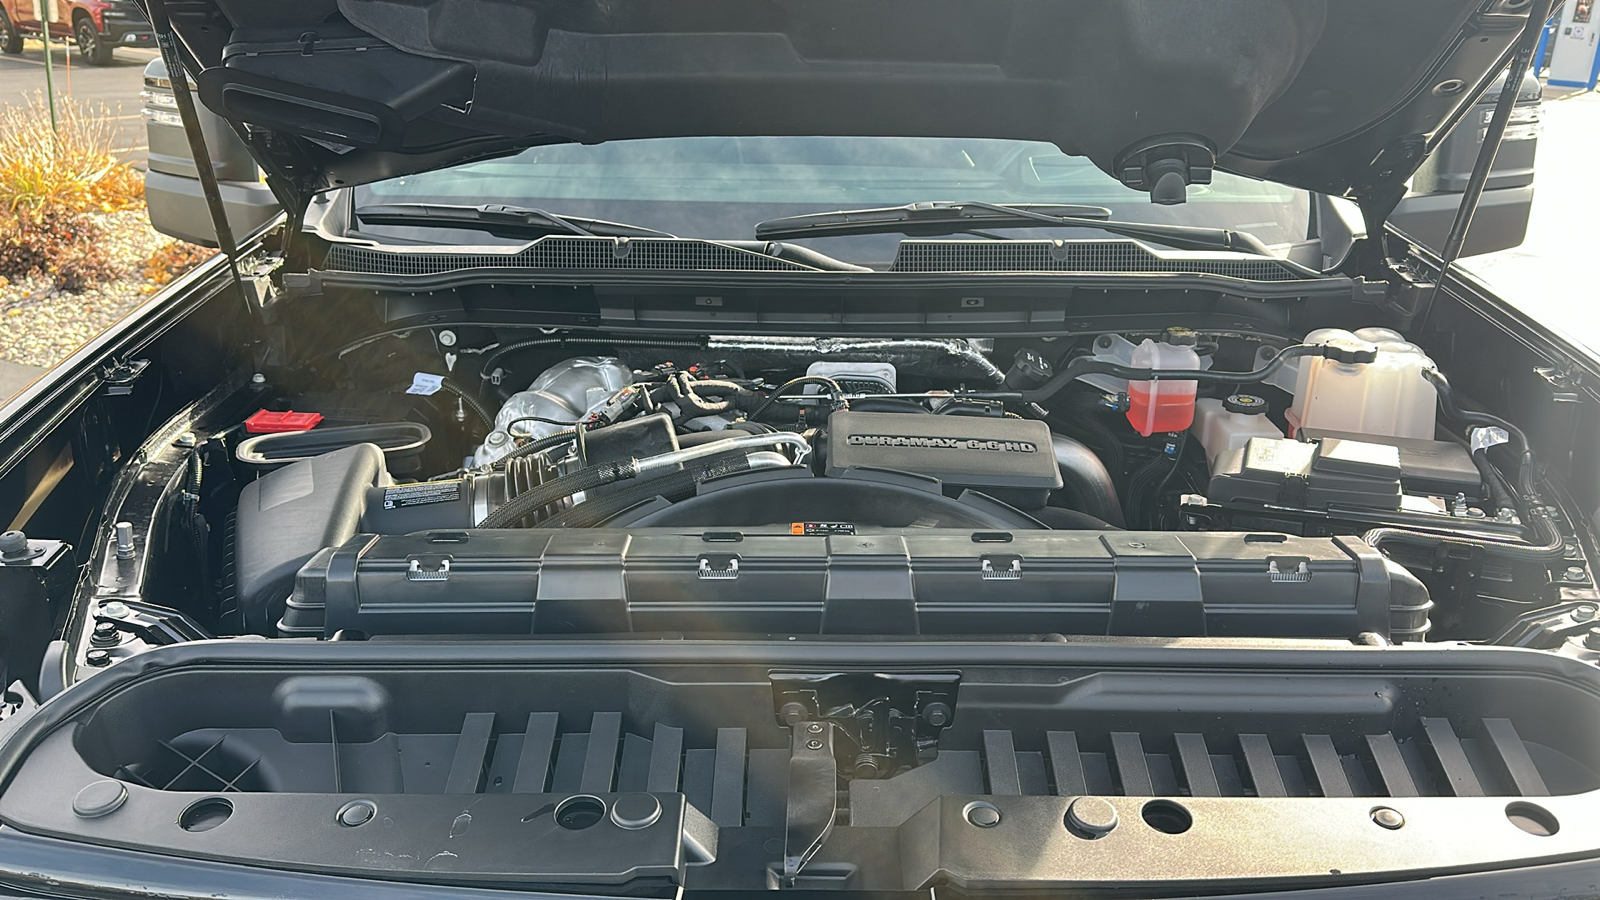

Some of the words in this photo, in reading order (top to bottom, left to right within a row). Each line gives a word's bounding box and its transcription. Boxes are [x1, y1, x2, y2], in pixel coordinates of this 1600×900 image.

[849, 435, 958, 448] DURAMAX
[966, 439, 1000, 450] 6.6
[1005, 441, 1036, 453] HD
